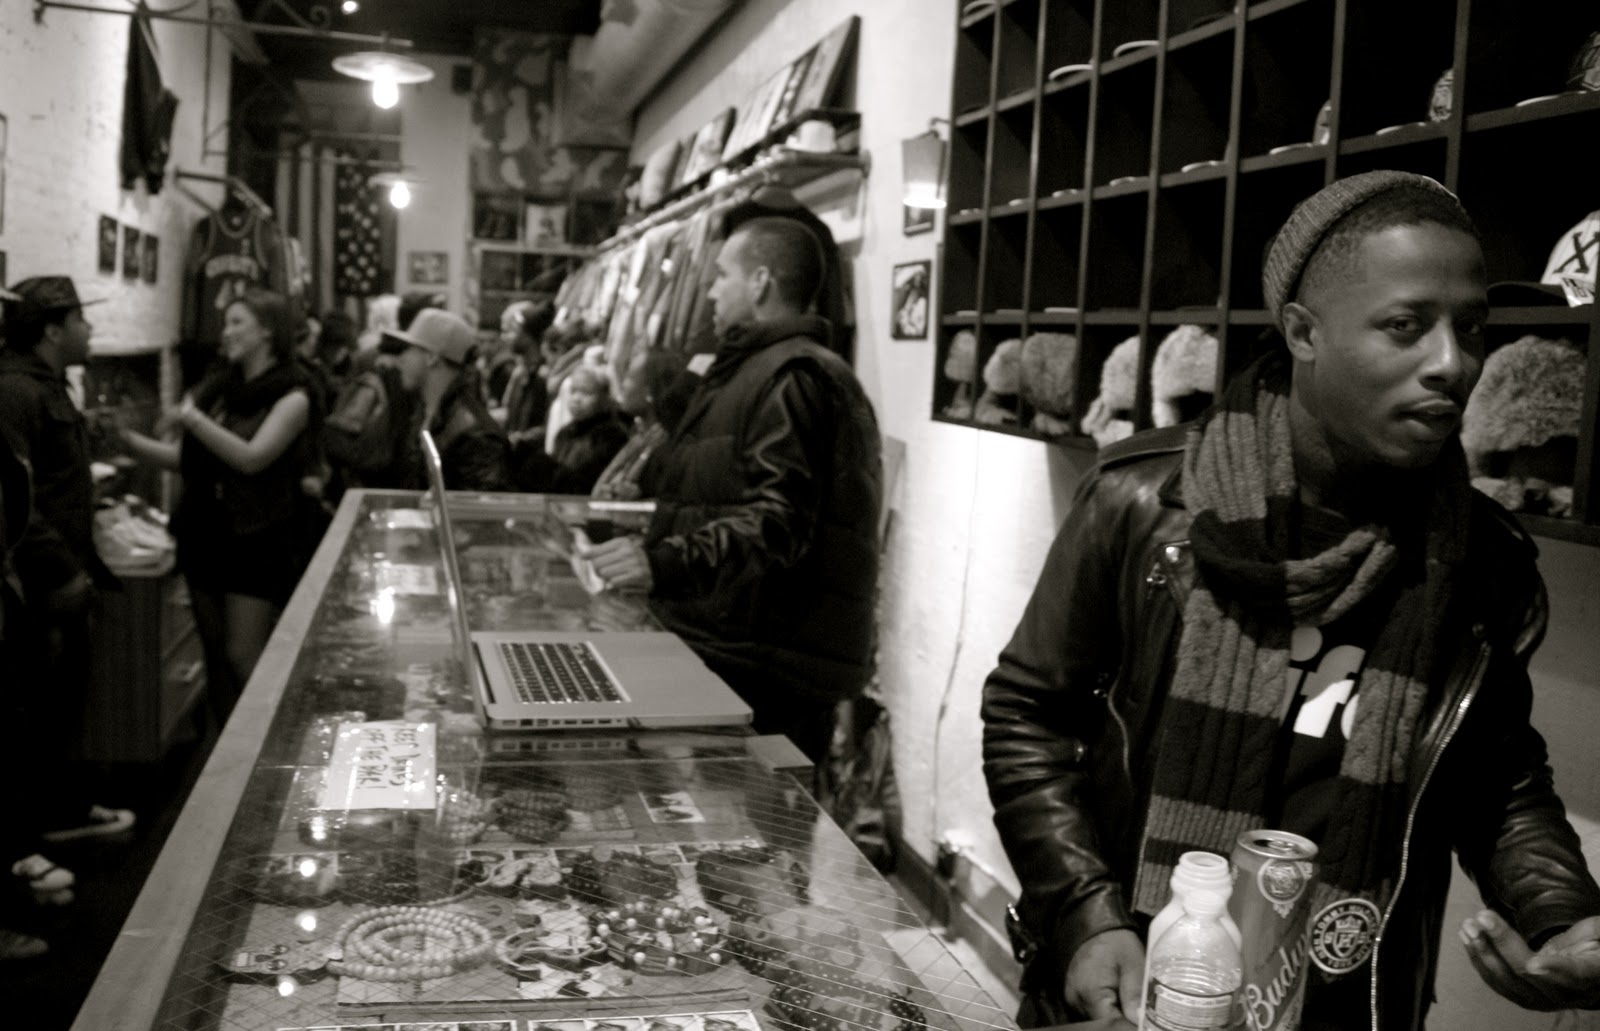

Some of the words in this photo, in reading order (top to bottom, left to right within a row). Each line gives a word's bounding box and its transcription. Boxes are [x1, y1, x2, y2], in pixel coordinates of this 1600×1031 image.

[1553, 231, 1600, 274] X
[360, 729, 387, 744] OFF
[1313, 906, 1345, 935] TOMMY
